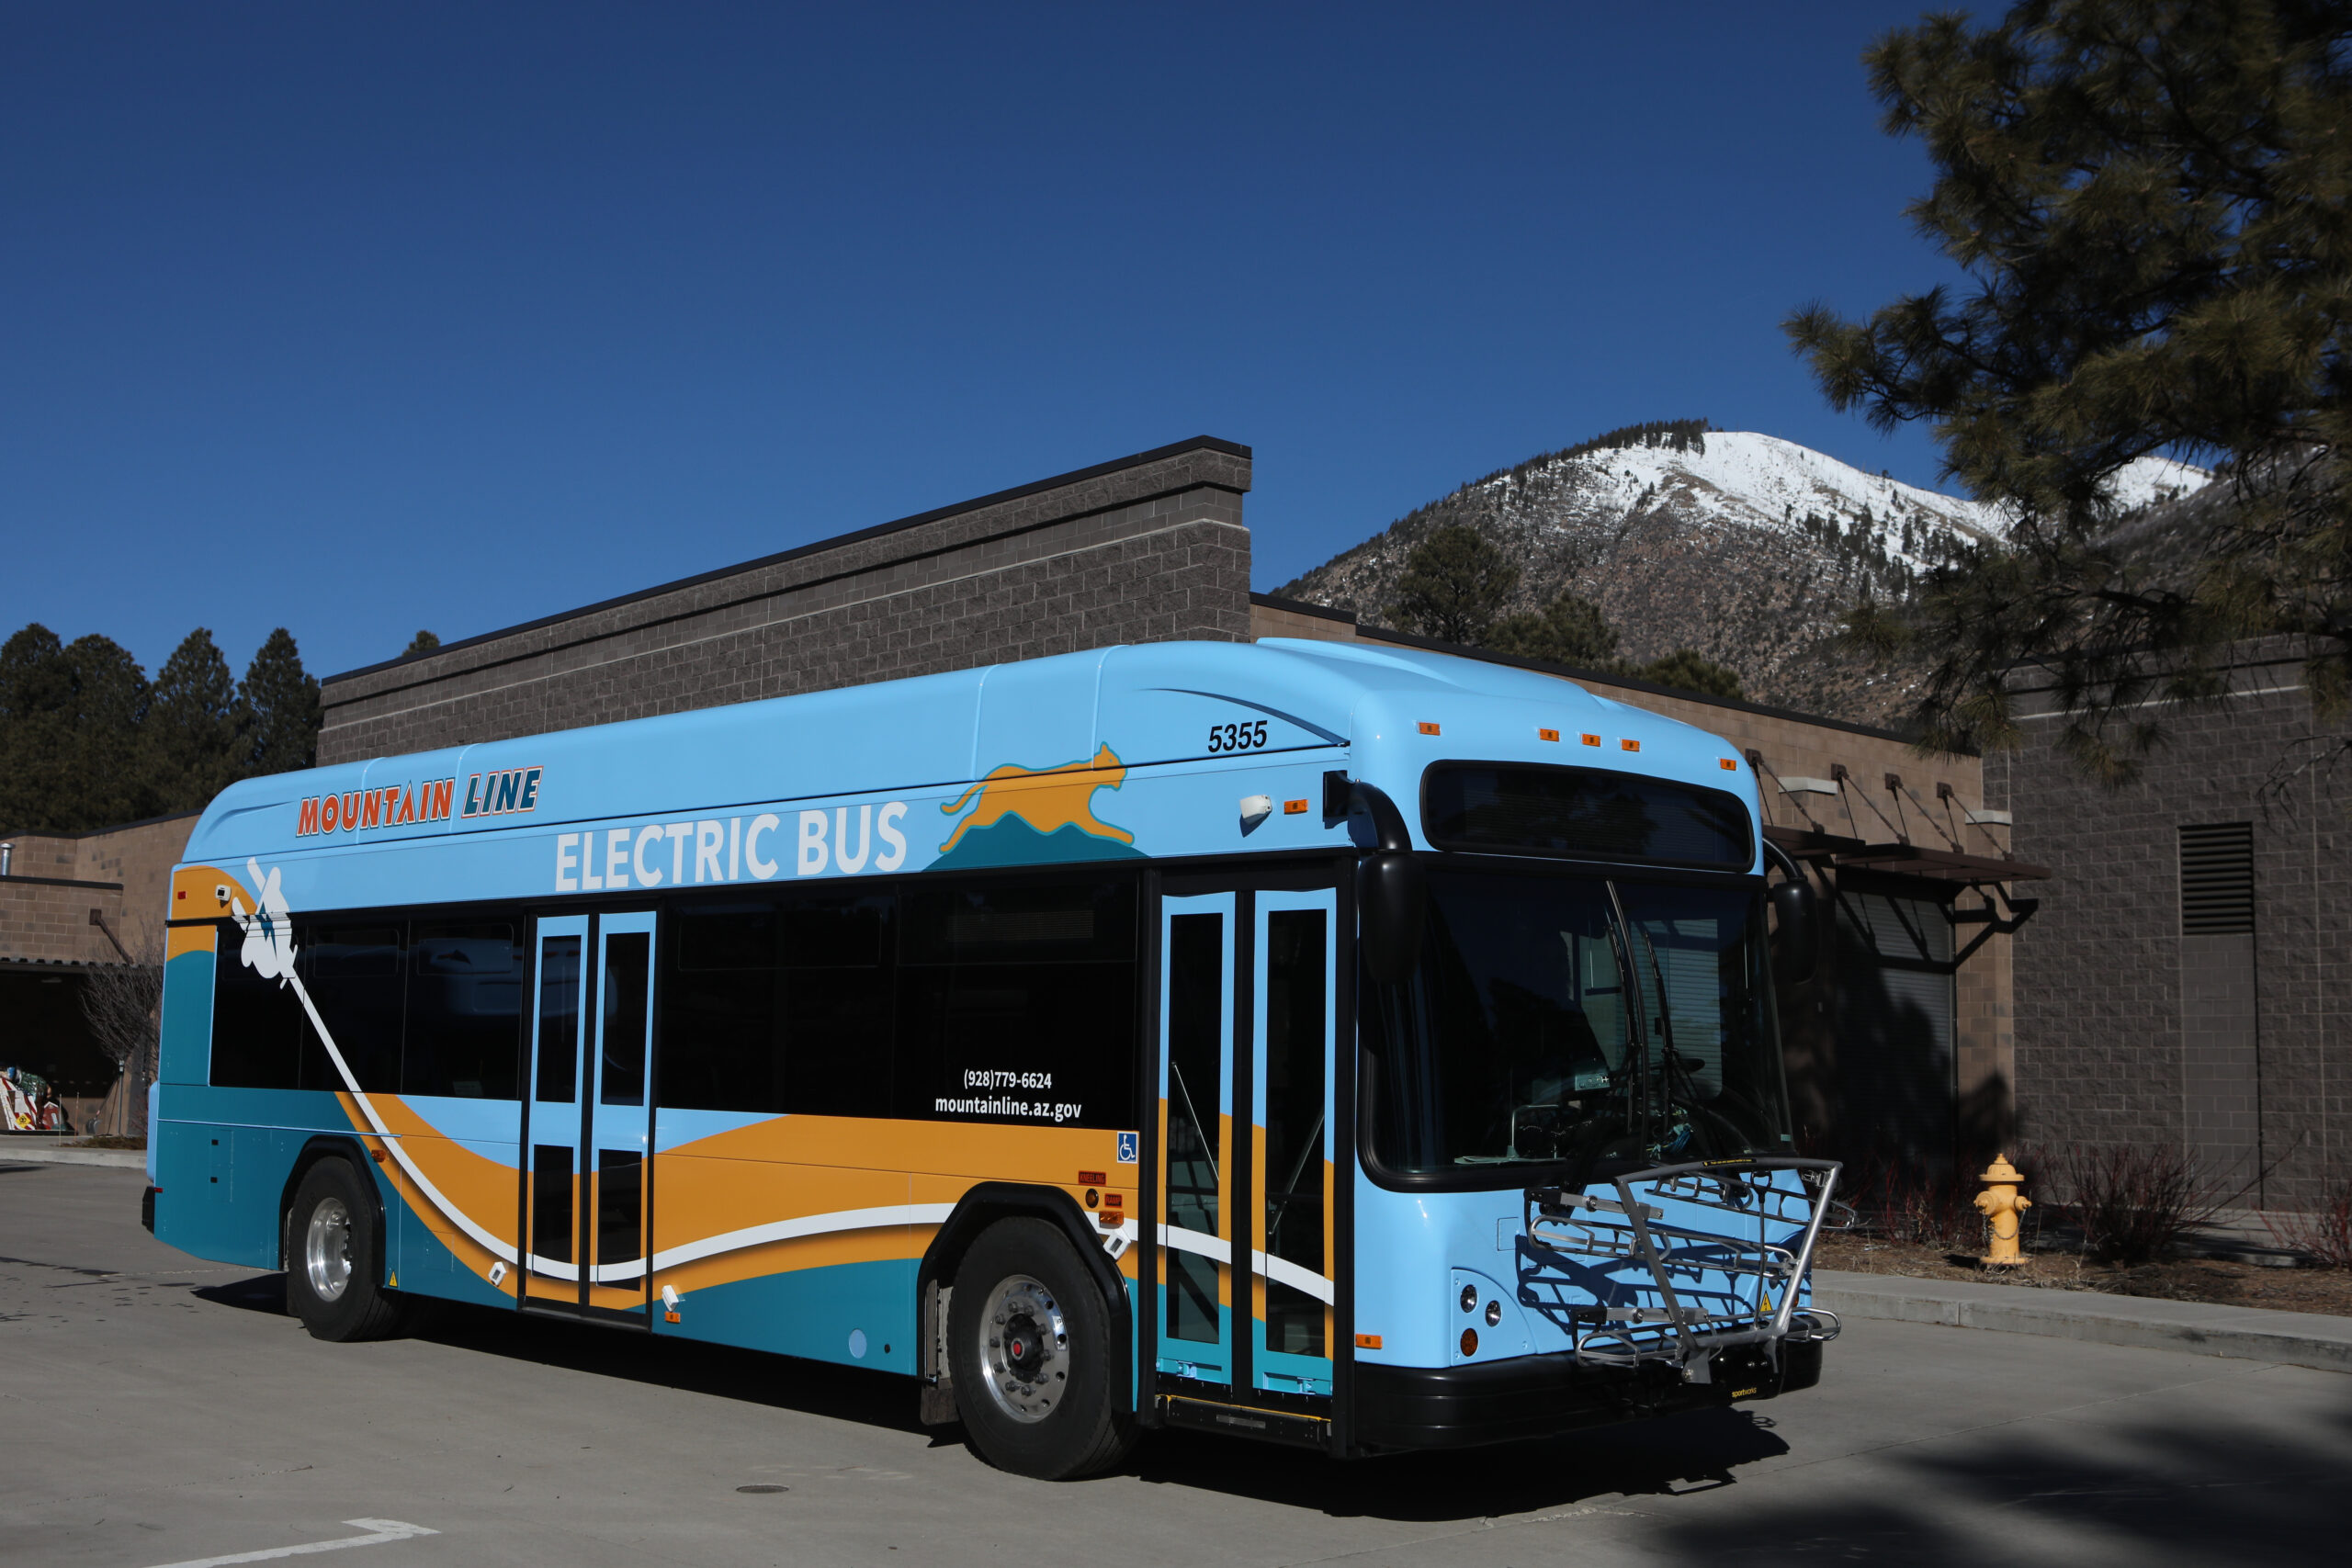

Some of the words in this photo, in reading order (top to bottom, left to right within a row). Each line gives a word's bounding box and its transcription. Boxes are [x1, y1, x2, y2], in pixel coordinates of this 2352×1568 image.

[1207, 719, 1268, 753] 5355
[296, 777, 456, 838] MOUNTAIN
[461, 765, 544, 818] LINE
[555, 813, 781, 892] ELECTRIC
[797, 801, 909, 876] BUS
[964, 1068, 1052, 1090] (928)779-6624
[934, 1095, 1082, 1122] mountainline.az.gov
[1105, 1196, 1121, 1204] RAMP
